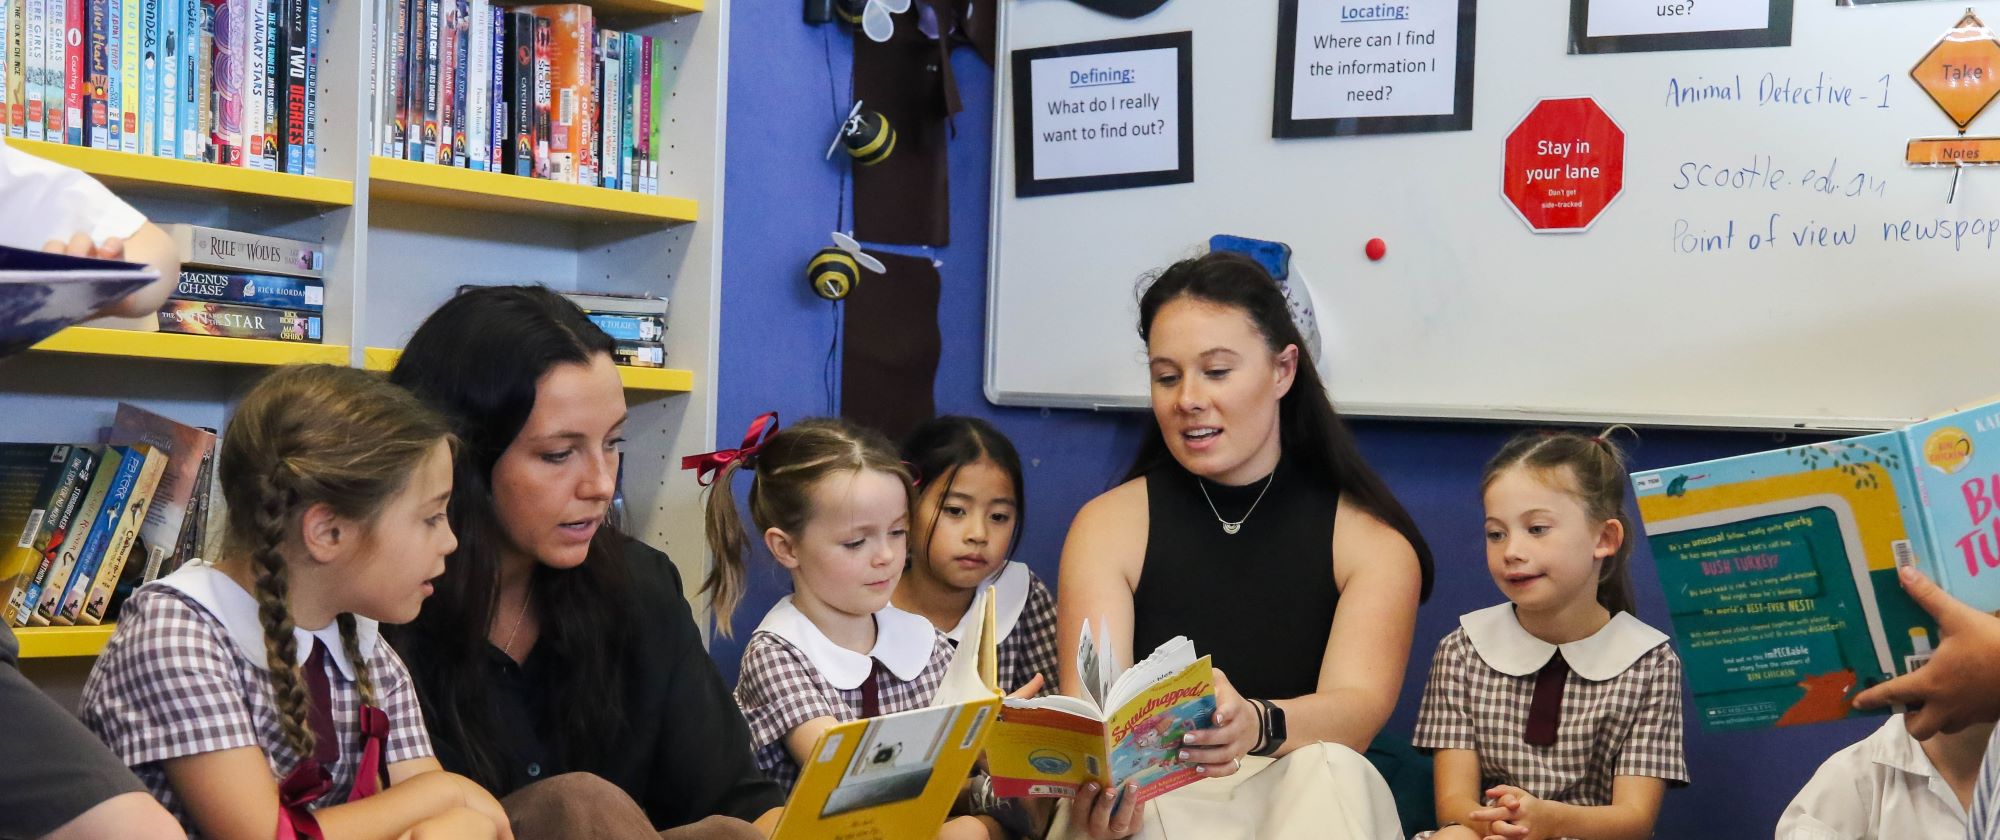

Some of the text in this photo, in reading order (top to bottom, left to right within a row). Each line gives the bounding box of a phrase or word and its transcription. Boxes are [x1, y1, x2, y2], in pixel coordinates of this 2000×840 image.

[430, 2, 439, 16] THE
[1340, 5, 1410, 22] Locating:
[1657, 0, 1694, 17] use?
[429, 17, 439, 40] DEATH
[1313, 29, 1435, 49] Where can I find
[34, 25, 42, 58] GIRLS
[54, 28, 63, 62] GIRLS
[93, 33, 106, 71] Heart
[429, 40, 439, 60] CURE
[578, 27, 586, 59] GOING
[252, 9, 264, 97] JANUARY STARS
[266, 12, 276, 125] THE MAZE RUNNER JAMES DASHNER
[428, 64, 438, 84] JAMES
[495, 55, 504, 86] WORDS
[578, 60, 586, 87] SOLO
[1069, 67, 1136, 86] Defining:
[1310, 58, 1435, 76] the information I
[1942, 64, 1983, 81] Take
[69, 55, 78, 104] Counting by
[309, 65, 317, 96] HUDA
[289, 46, 306, 145] TWO DEGREES
[520, 77, 528, 121] CATCHING
[1347, 85, 1393, 102] need?
[1665, 75, 1742, 108] Animal
[581, 96, 589, 118] ZOE
[1047, 93, 1160, 116] What do I really
[1043, 119, 1165, 143] want to find out?
[1537, 138, 1590, 158] Stay in
[1942, 148, 1980, 159] Notes
[1526, 164, 1600, 185] your lane
[1566, 189, 1577, 197] get
[1541, 201, 1583, 209] side-tracked
[1673, 219, 1734, 253] Point
[1748, 213, 1781, 250] of
[1793, 221, 1856, 248] view
[210, 236, 236, 259] RULE
[247, 239, 281, 262] WOLVES
[178, 282, 225, 297] CHASE
[179, 272, 229, 286] MAGNUS
[223, 313, 265, 330] STAR
[280, 332, 304, 341] OSHIRO
[114, 473, 133, 501] KERR
[58, 486, 81, 531] STORMBREAKER
[1692, 532, 1725, 547] unusual
[1784, 518, 1813, 529] quirky
[34, 557, 50, 585] ANTHONY
[1701, 558, 1731, 577] BUSH
[1746, 602, 1786, 614] BEST-EVER
[1788, 599, 1815, 612] NEST!
[1747, 668, 1796, 682] BIN CHICKEN
[1112, 680, 1209, 747] Squidnapped!
[1717, 703, 1774, 715] SCHOLASTIC
